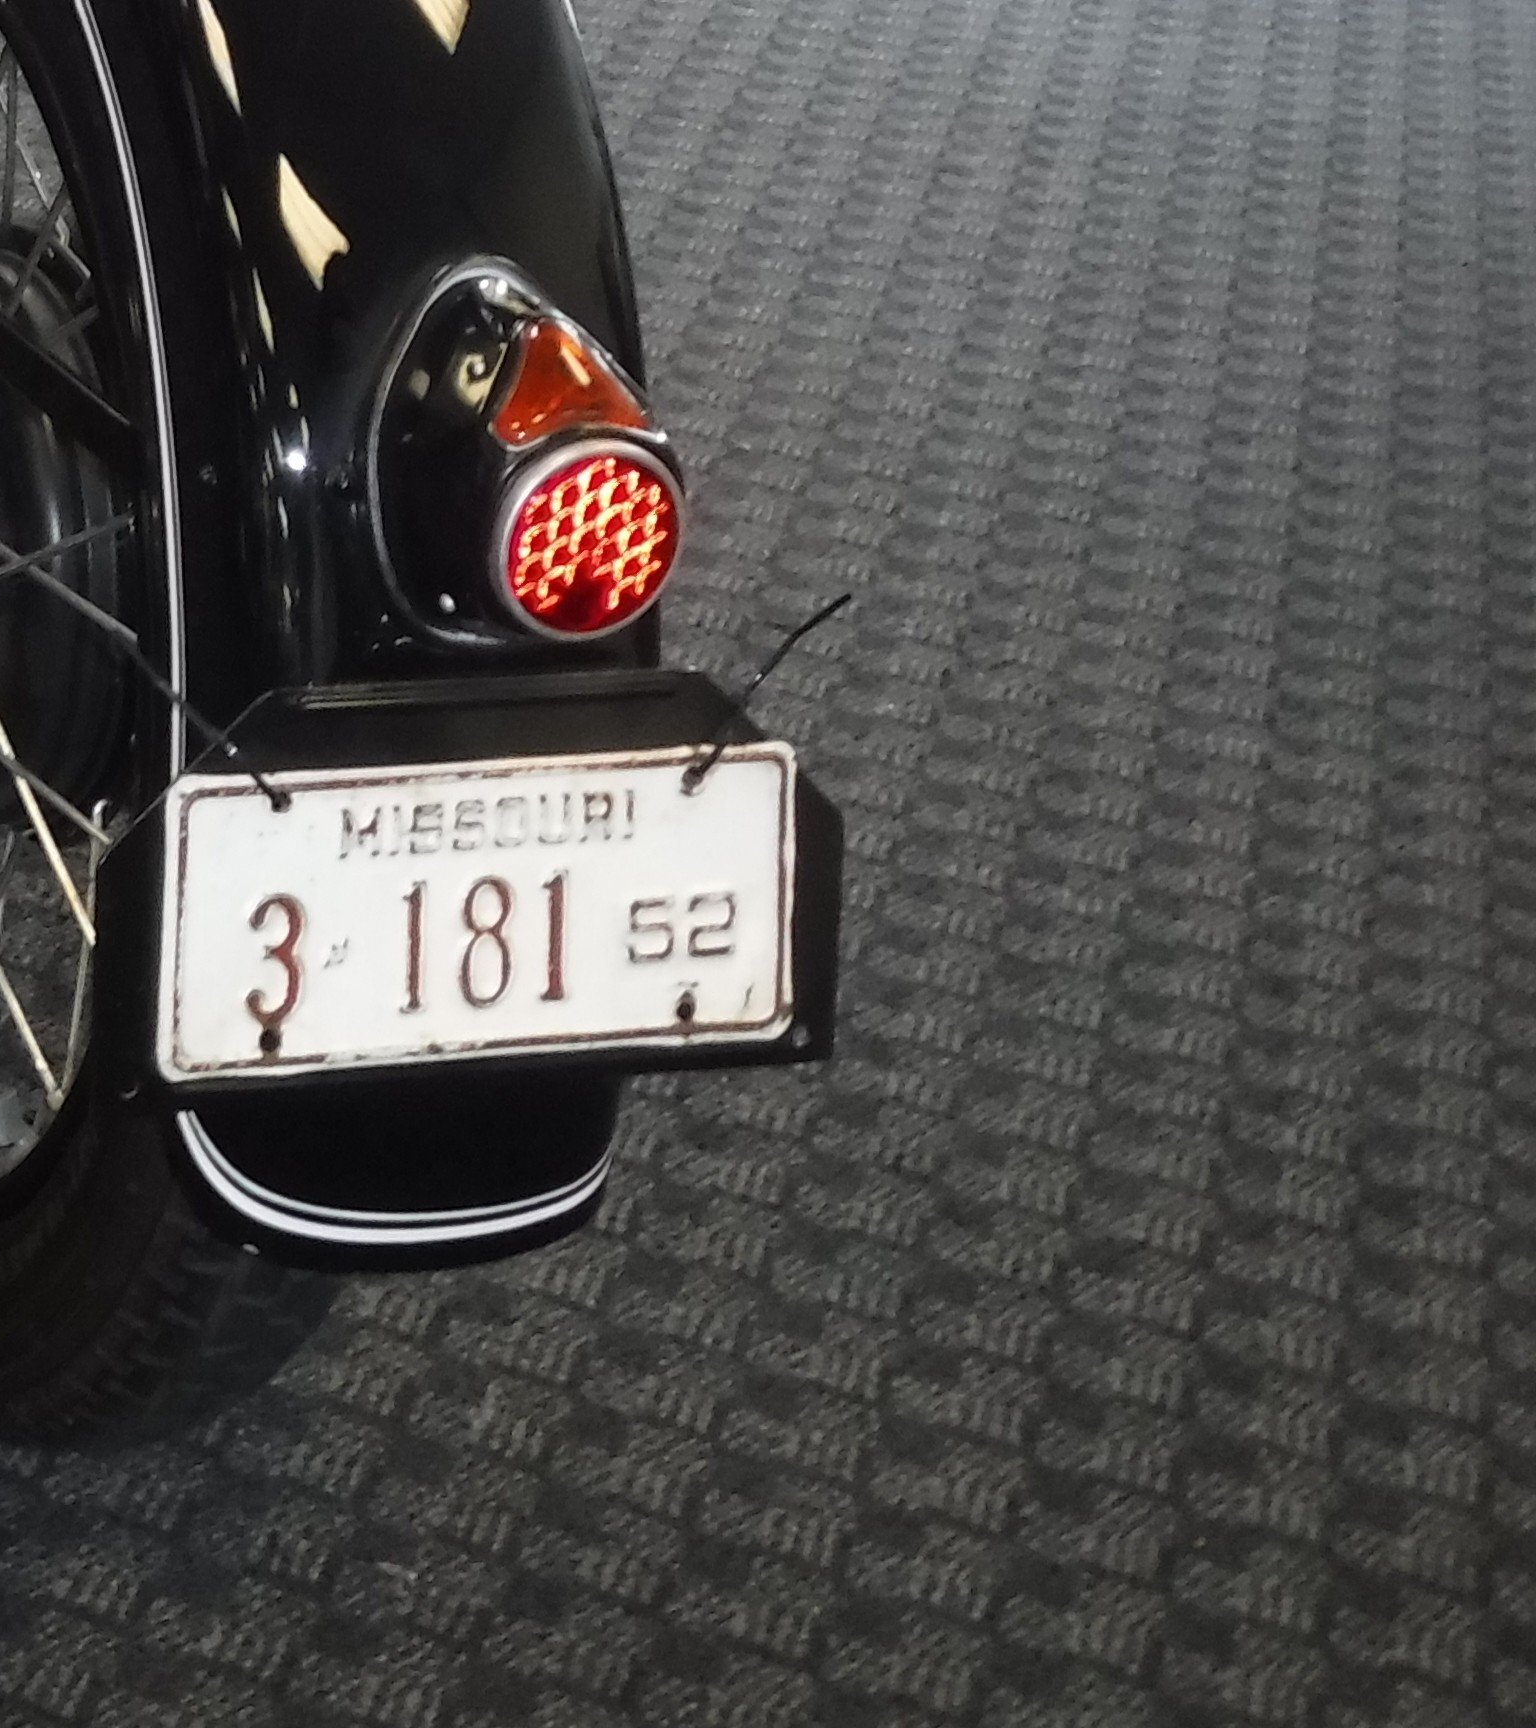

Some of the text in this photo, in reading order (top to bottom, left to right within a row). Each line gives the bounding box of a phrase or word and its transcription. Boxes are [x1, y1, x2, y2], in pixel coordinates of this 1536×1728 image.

[338, 788, 636, 860] MISSOURI
[243, 869, 737, 1027] 3 181 52
